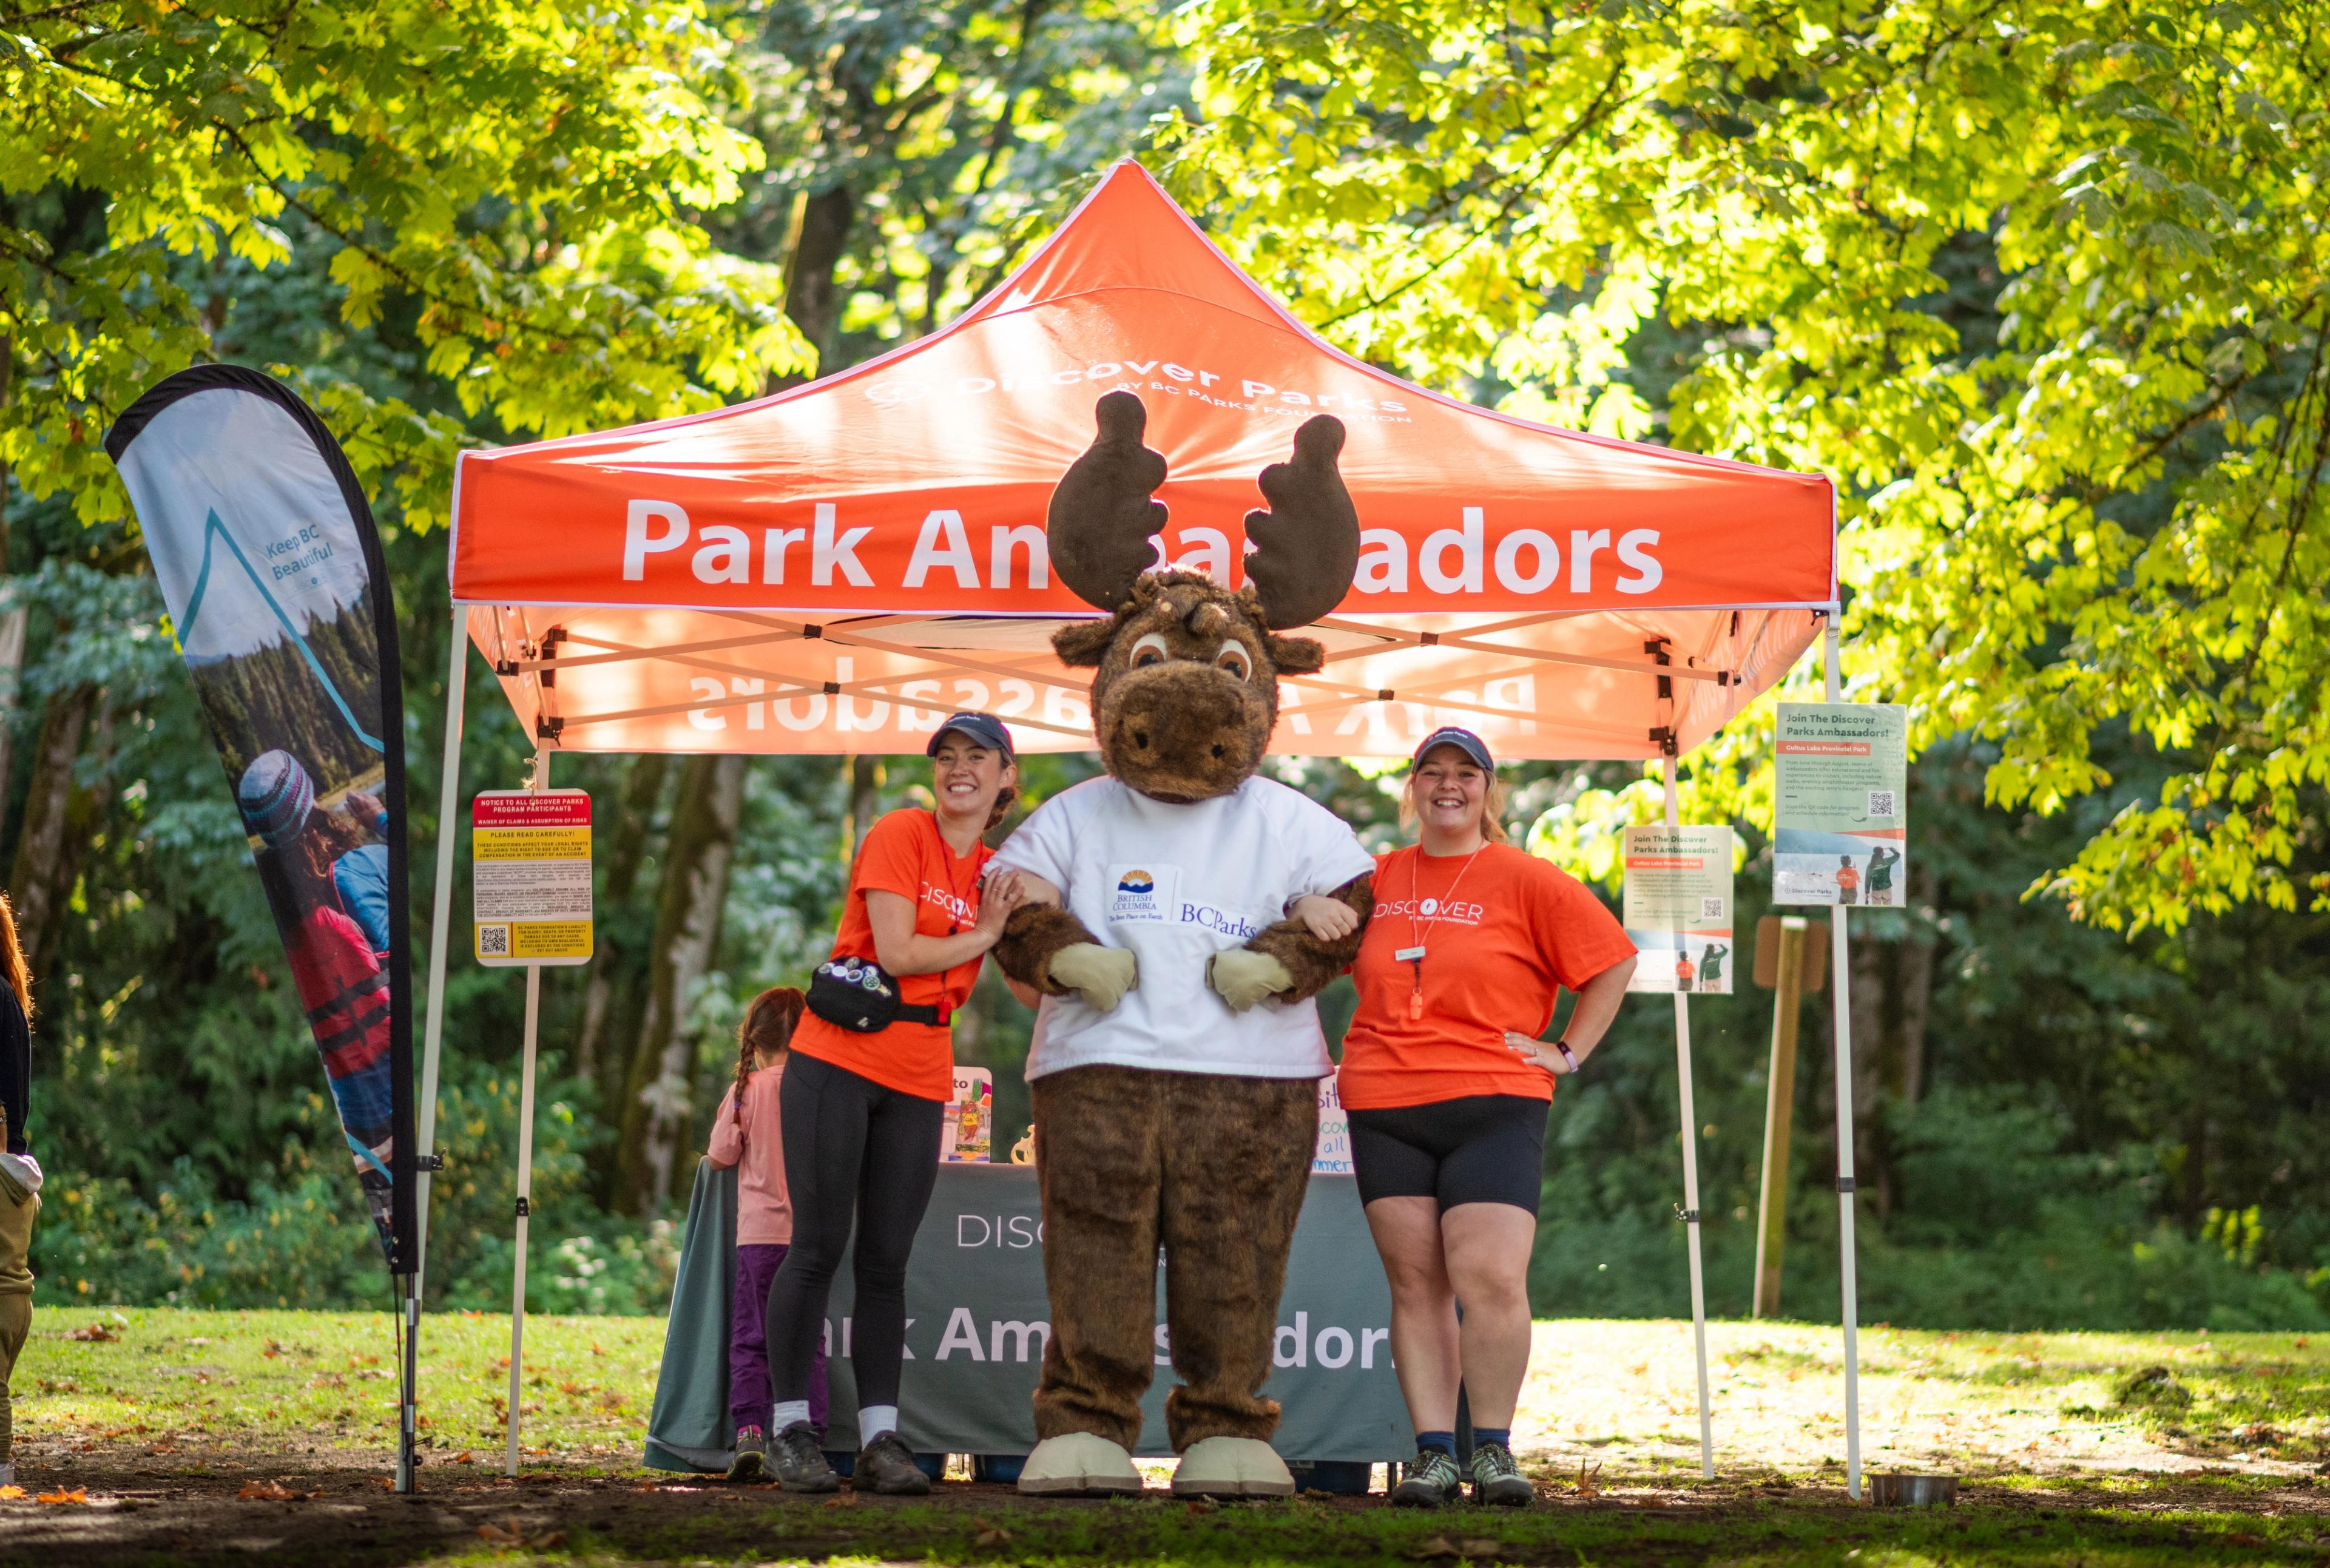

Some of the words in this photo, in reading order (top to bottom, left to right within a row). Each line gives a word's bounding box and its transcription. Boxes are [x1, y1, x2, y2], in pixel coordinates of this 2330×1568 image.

[1151, 382, 1180, 394] BC
[1188, 388, 1255, 410] PARKS
[1242, 379, 1406, 413] Parks
[266, 536, 300, 558] Keep
[299, 524, 319, 543] BC
[623, 499, 876, 587] Park
[272, 542, 333, 580] Beautiful
[1786, 714, 1806, 722] Join
[1809, 714, 1828, 723] The
[1831, 714, 1875, 724] Discover
[1787, 727, 1814, 735] Parks
[1817, 728, 1888, 737] Ambassadors!
[1659, 845, 1718, 854] Ambassadors!
[1113, 902, 1157, 911] COLUMBIA
[1373, 898, 1484, 920] DISCOVER
[1442, 916, 1478, 925] FOUNDATION
[1324, 1136, 1344, 1153] all
